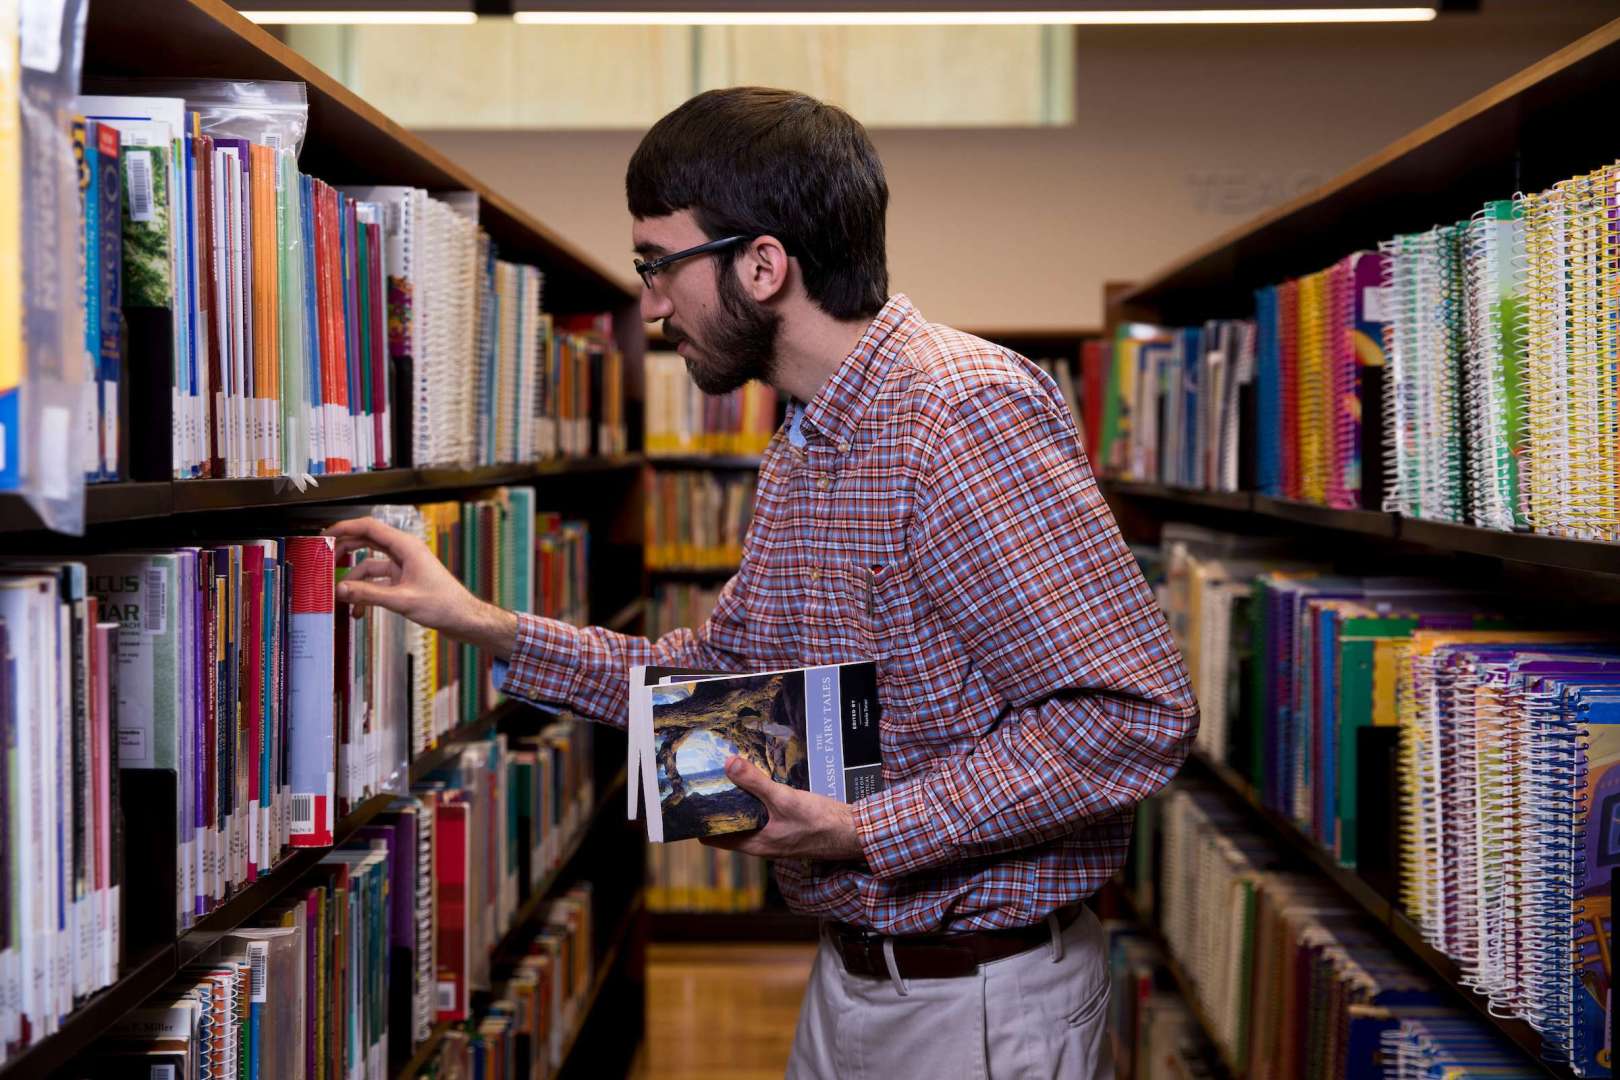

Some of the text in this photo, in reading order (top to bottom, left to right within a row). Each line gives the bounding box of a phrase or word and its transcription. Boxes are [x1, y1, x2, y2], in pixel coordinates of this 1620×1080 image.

[851, 699, 856, 708] BY
[816, 733, 824, 751] THE
[822, 676, 837, 798] LASSIC FAIRY TALES
[143, 1022, 174, 1033] Miller
